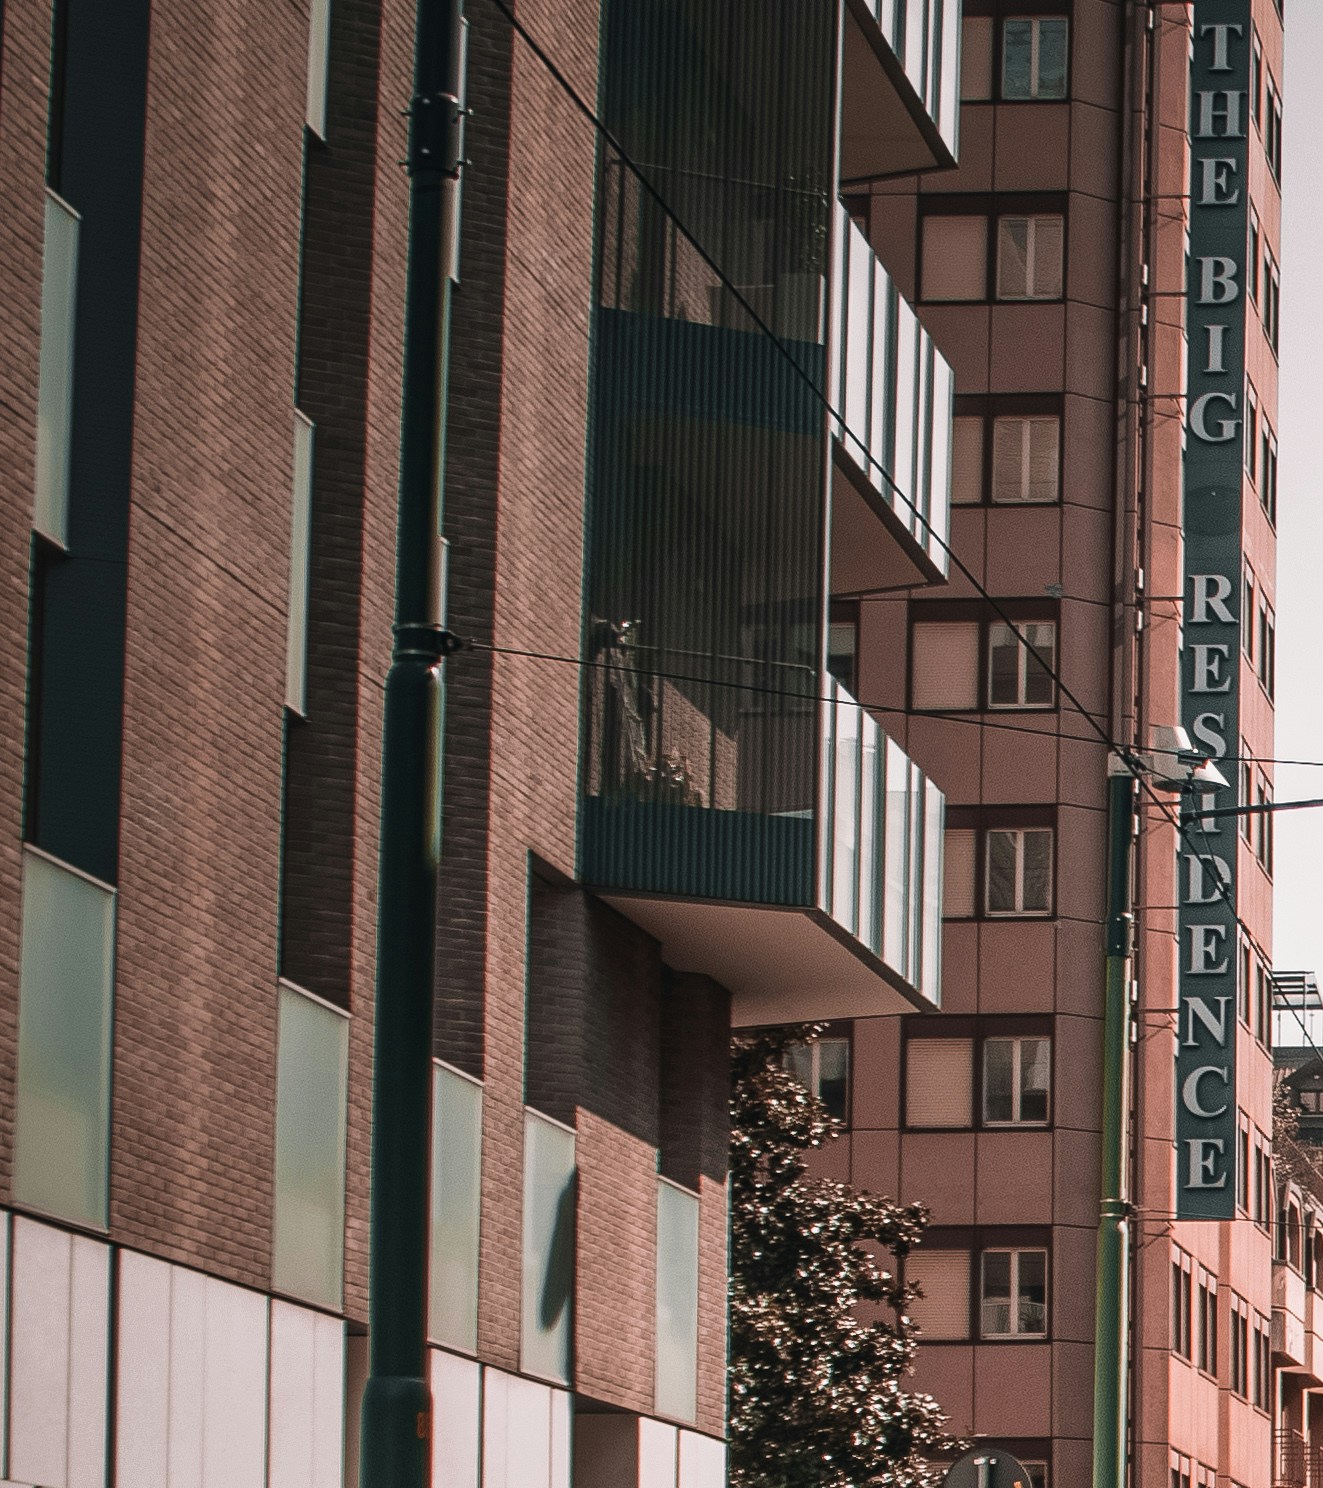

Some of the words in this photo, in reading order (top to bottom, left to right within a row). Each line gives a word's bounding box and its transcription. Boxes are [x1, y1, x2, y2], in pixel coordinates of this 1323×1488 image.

[1195, 24, 1247, 205] THE
[1190, 256, 1242, 443] BIG
[1181, 574, 1239, 1188] RESIDENCE
